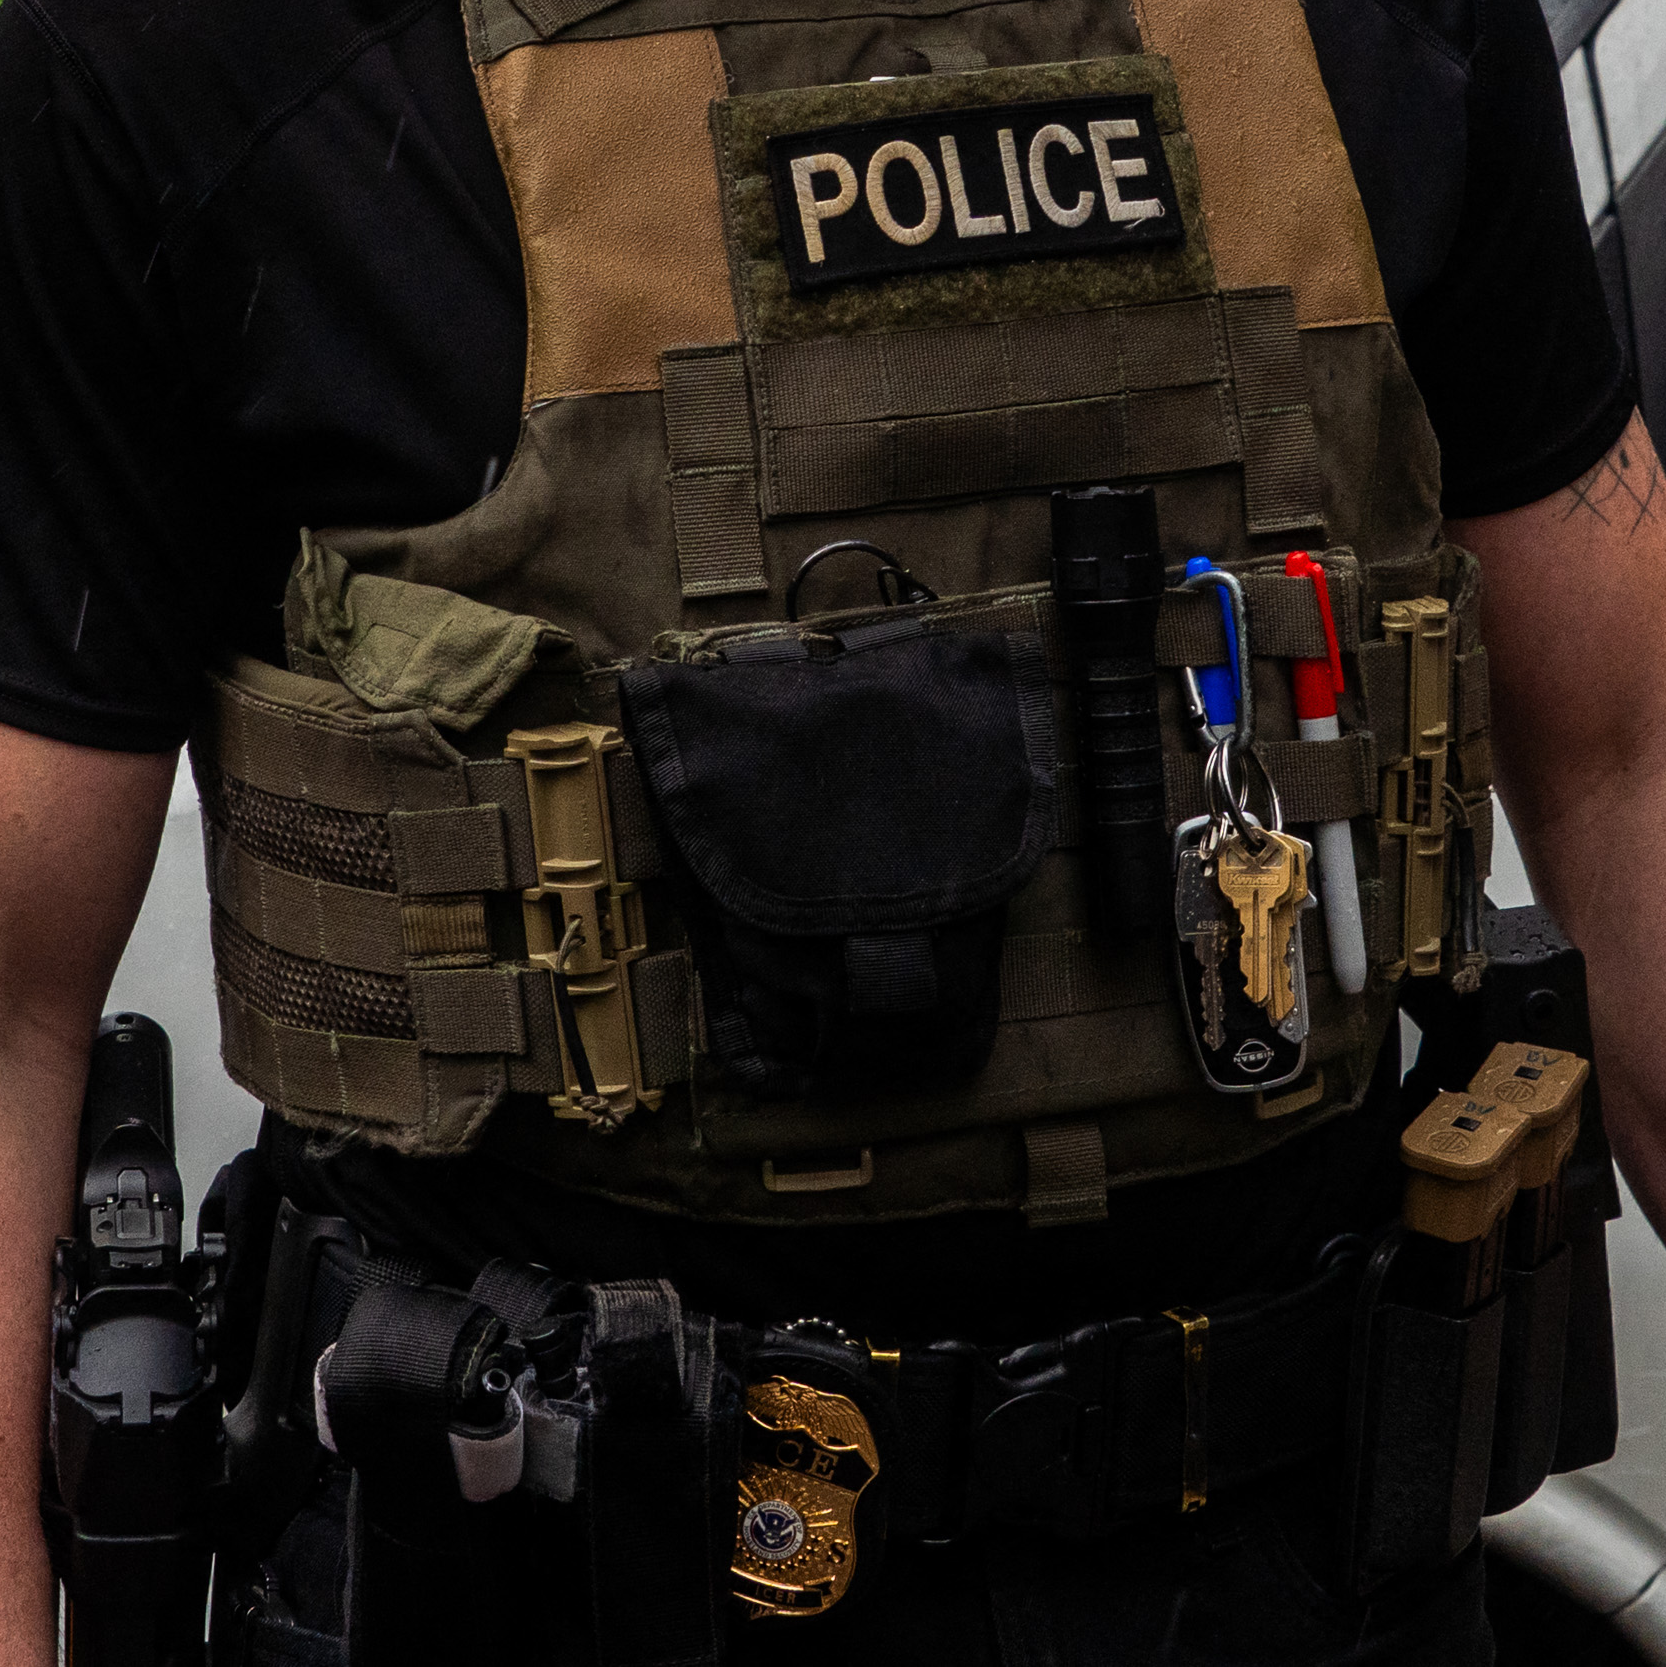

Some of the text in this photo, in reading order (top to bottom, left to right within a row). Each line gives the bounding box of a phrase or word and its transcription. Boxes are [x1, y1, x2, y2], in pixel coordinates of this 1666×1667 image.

[791, 120, 1164, 263] POLICE
[1234, 1050, 1275, 1062] NISSAN
[776, 1439, 839, 1480] CE
[755, 1584, 796, 1604] ICER
